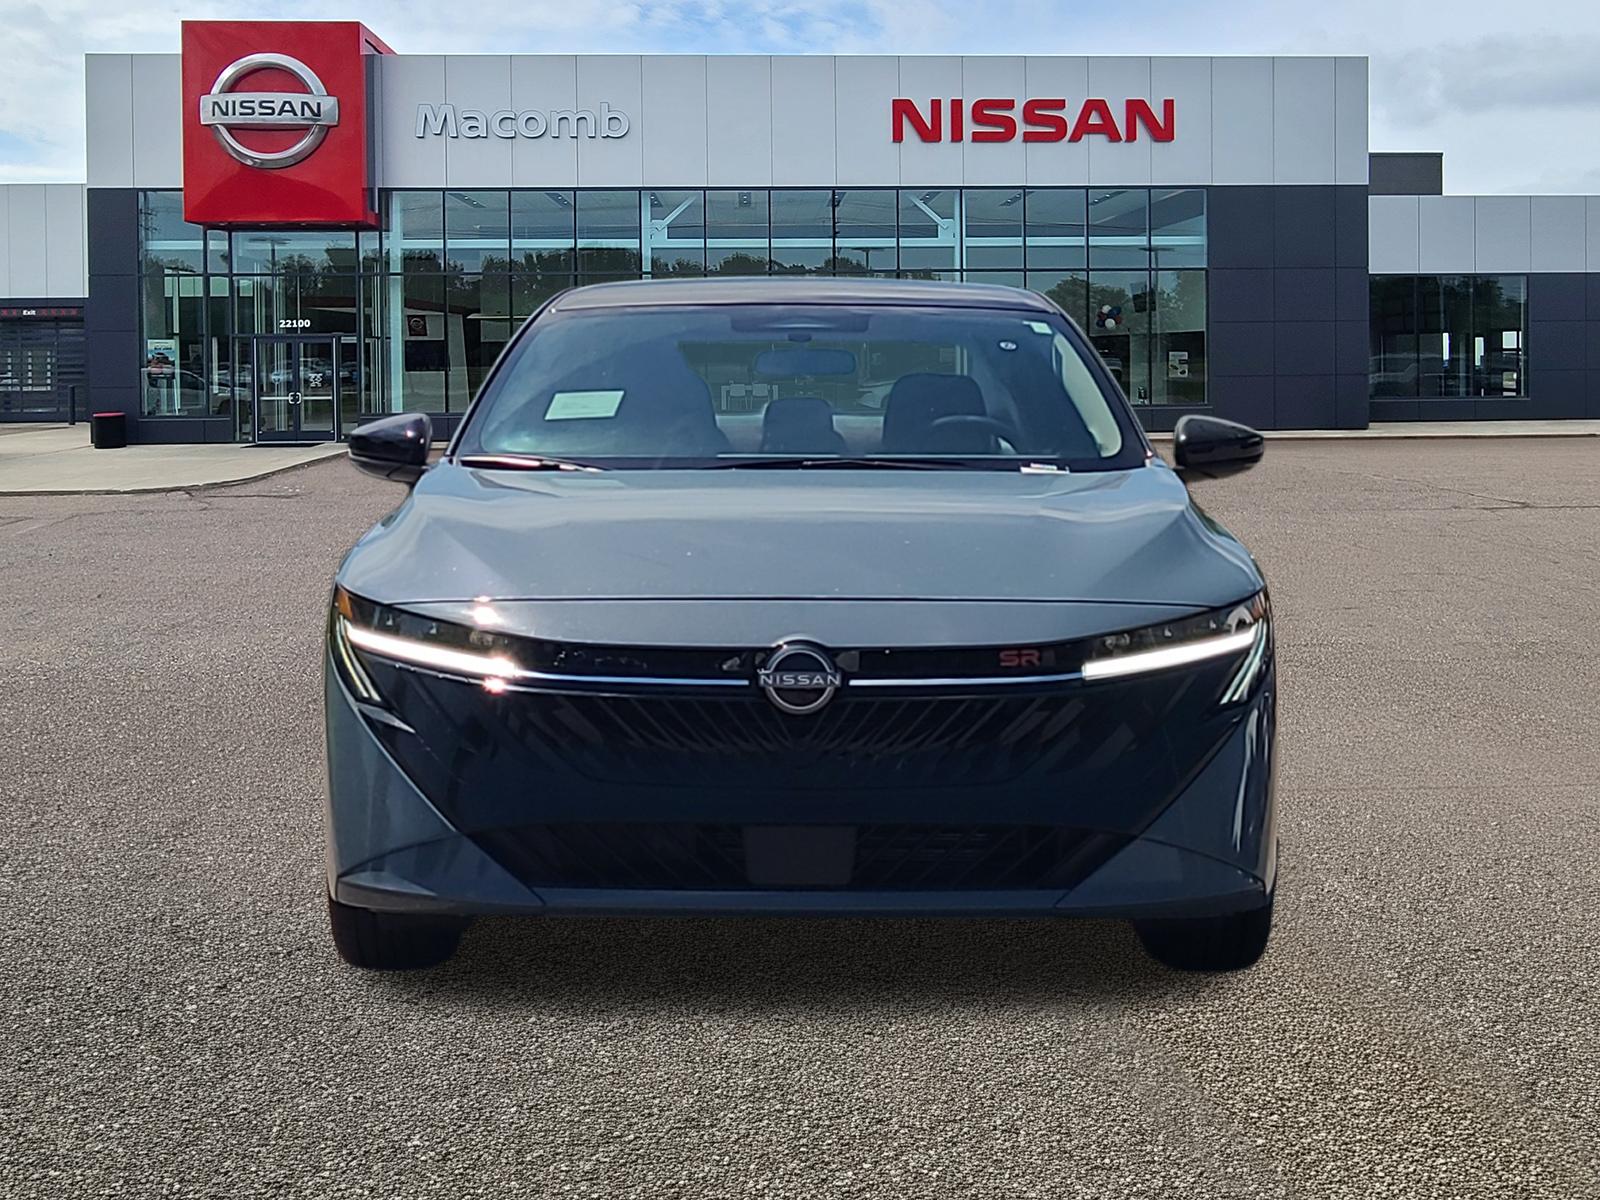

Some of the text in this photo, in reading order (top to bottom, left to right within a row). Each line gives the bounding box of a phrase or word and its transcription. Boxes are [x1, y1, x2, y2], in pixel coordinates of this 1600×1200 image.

[211, 100, 322, 117] NISSAN
[415, 102, 630, 139] Macomb
[892, 98, 1175, 143] NISSAN
[279, 319, 311, 328] 22100
[999, 648, 1041, 667] SR
[760, 675, 840, 685] NISSAN
